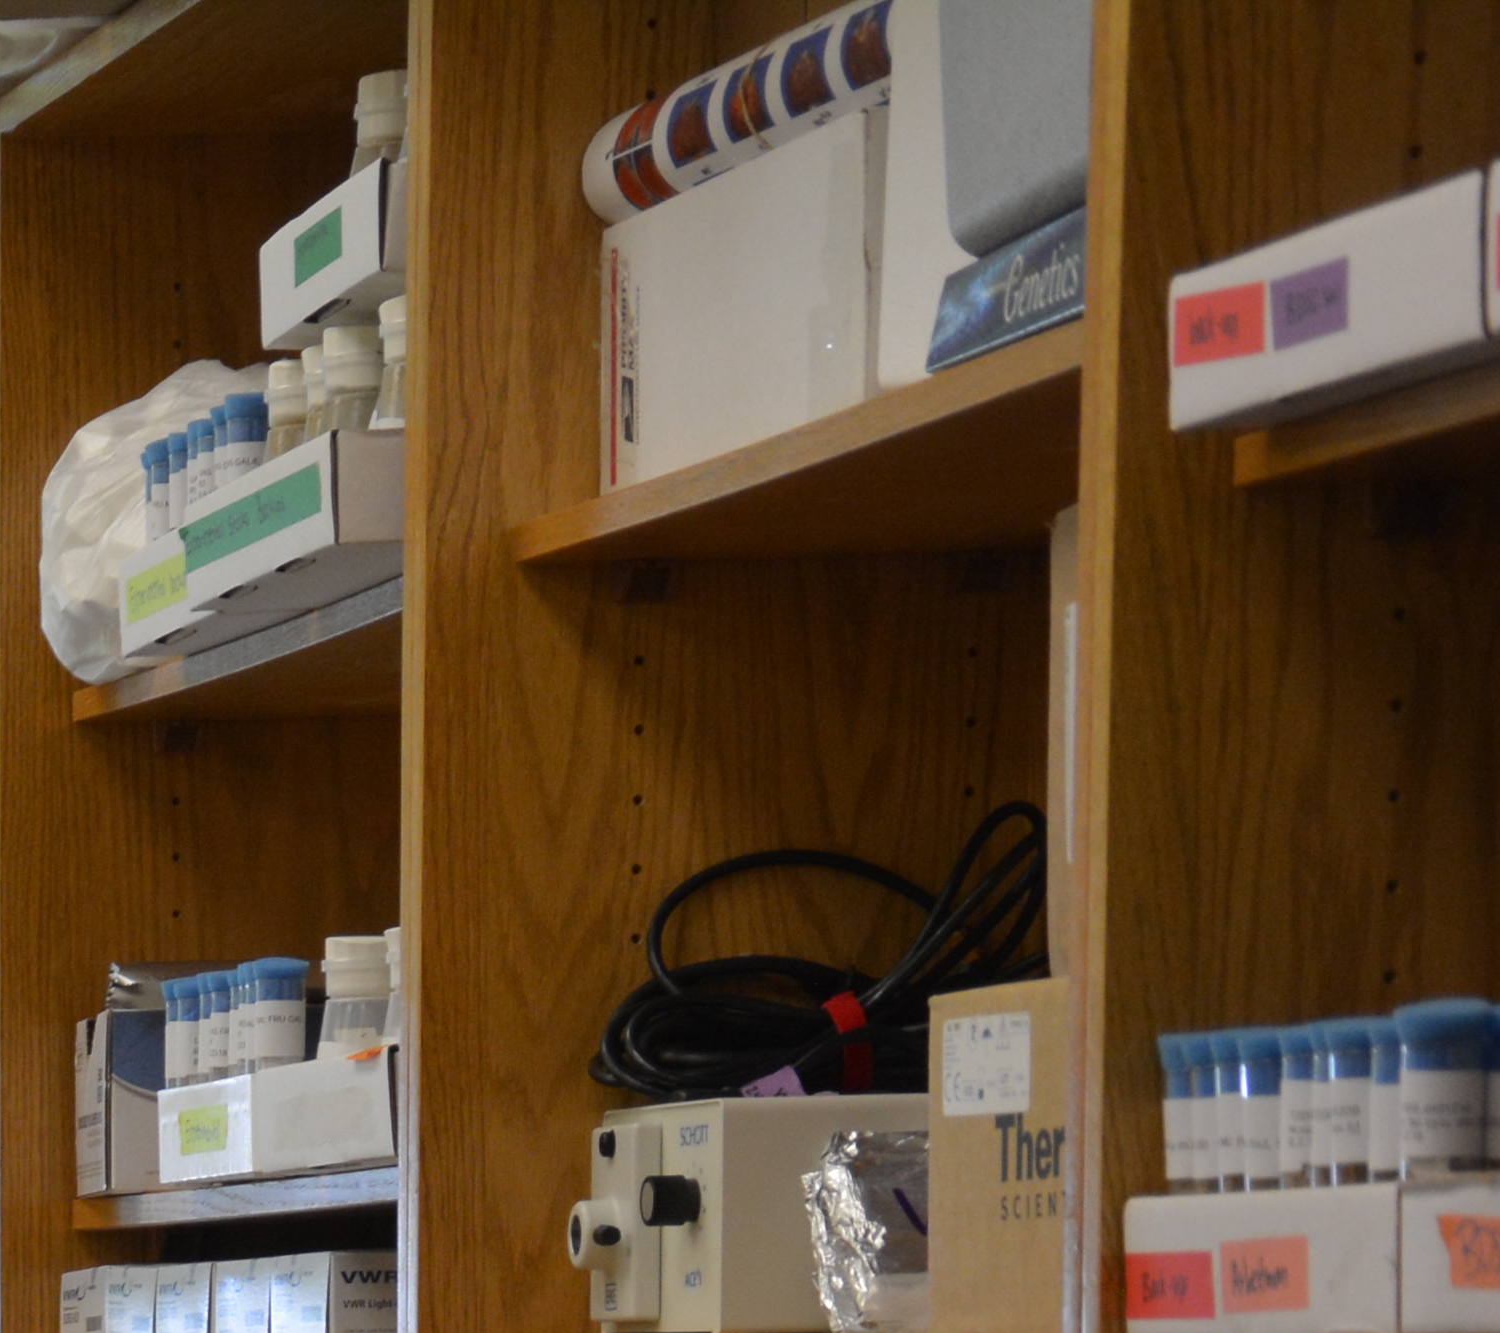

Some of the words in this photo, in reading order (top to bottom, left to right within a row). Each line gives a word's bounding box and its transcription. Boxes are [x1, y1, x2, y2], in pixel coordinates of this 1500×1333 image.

[1000, 243, 1080, 323] Genetics
[680, 1125, 709, 1147] SCHOTT
[995, 1113, 1065, 1183] Ther
[1001, 1191, 1065, 1221] SCIEN
[343, 1300, 366, 1310] VWR
